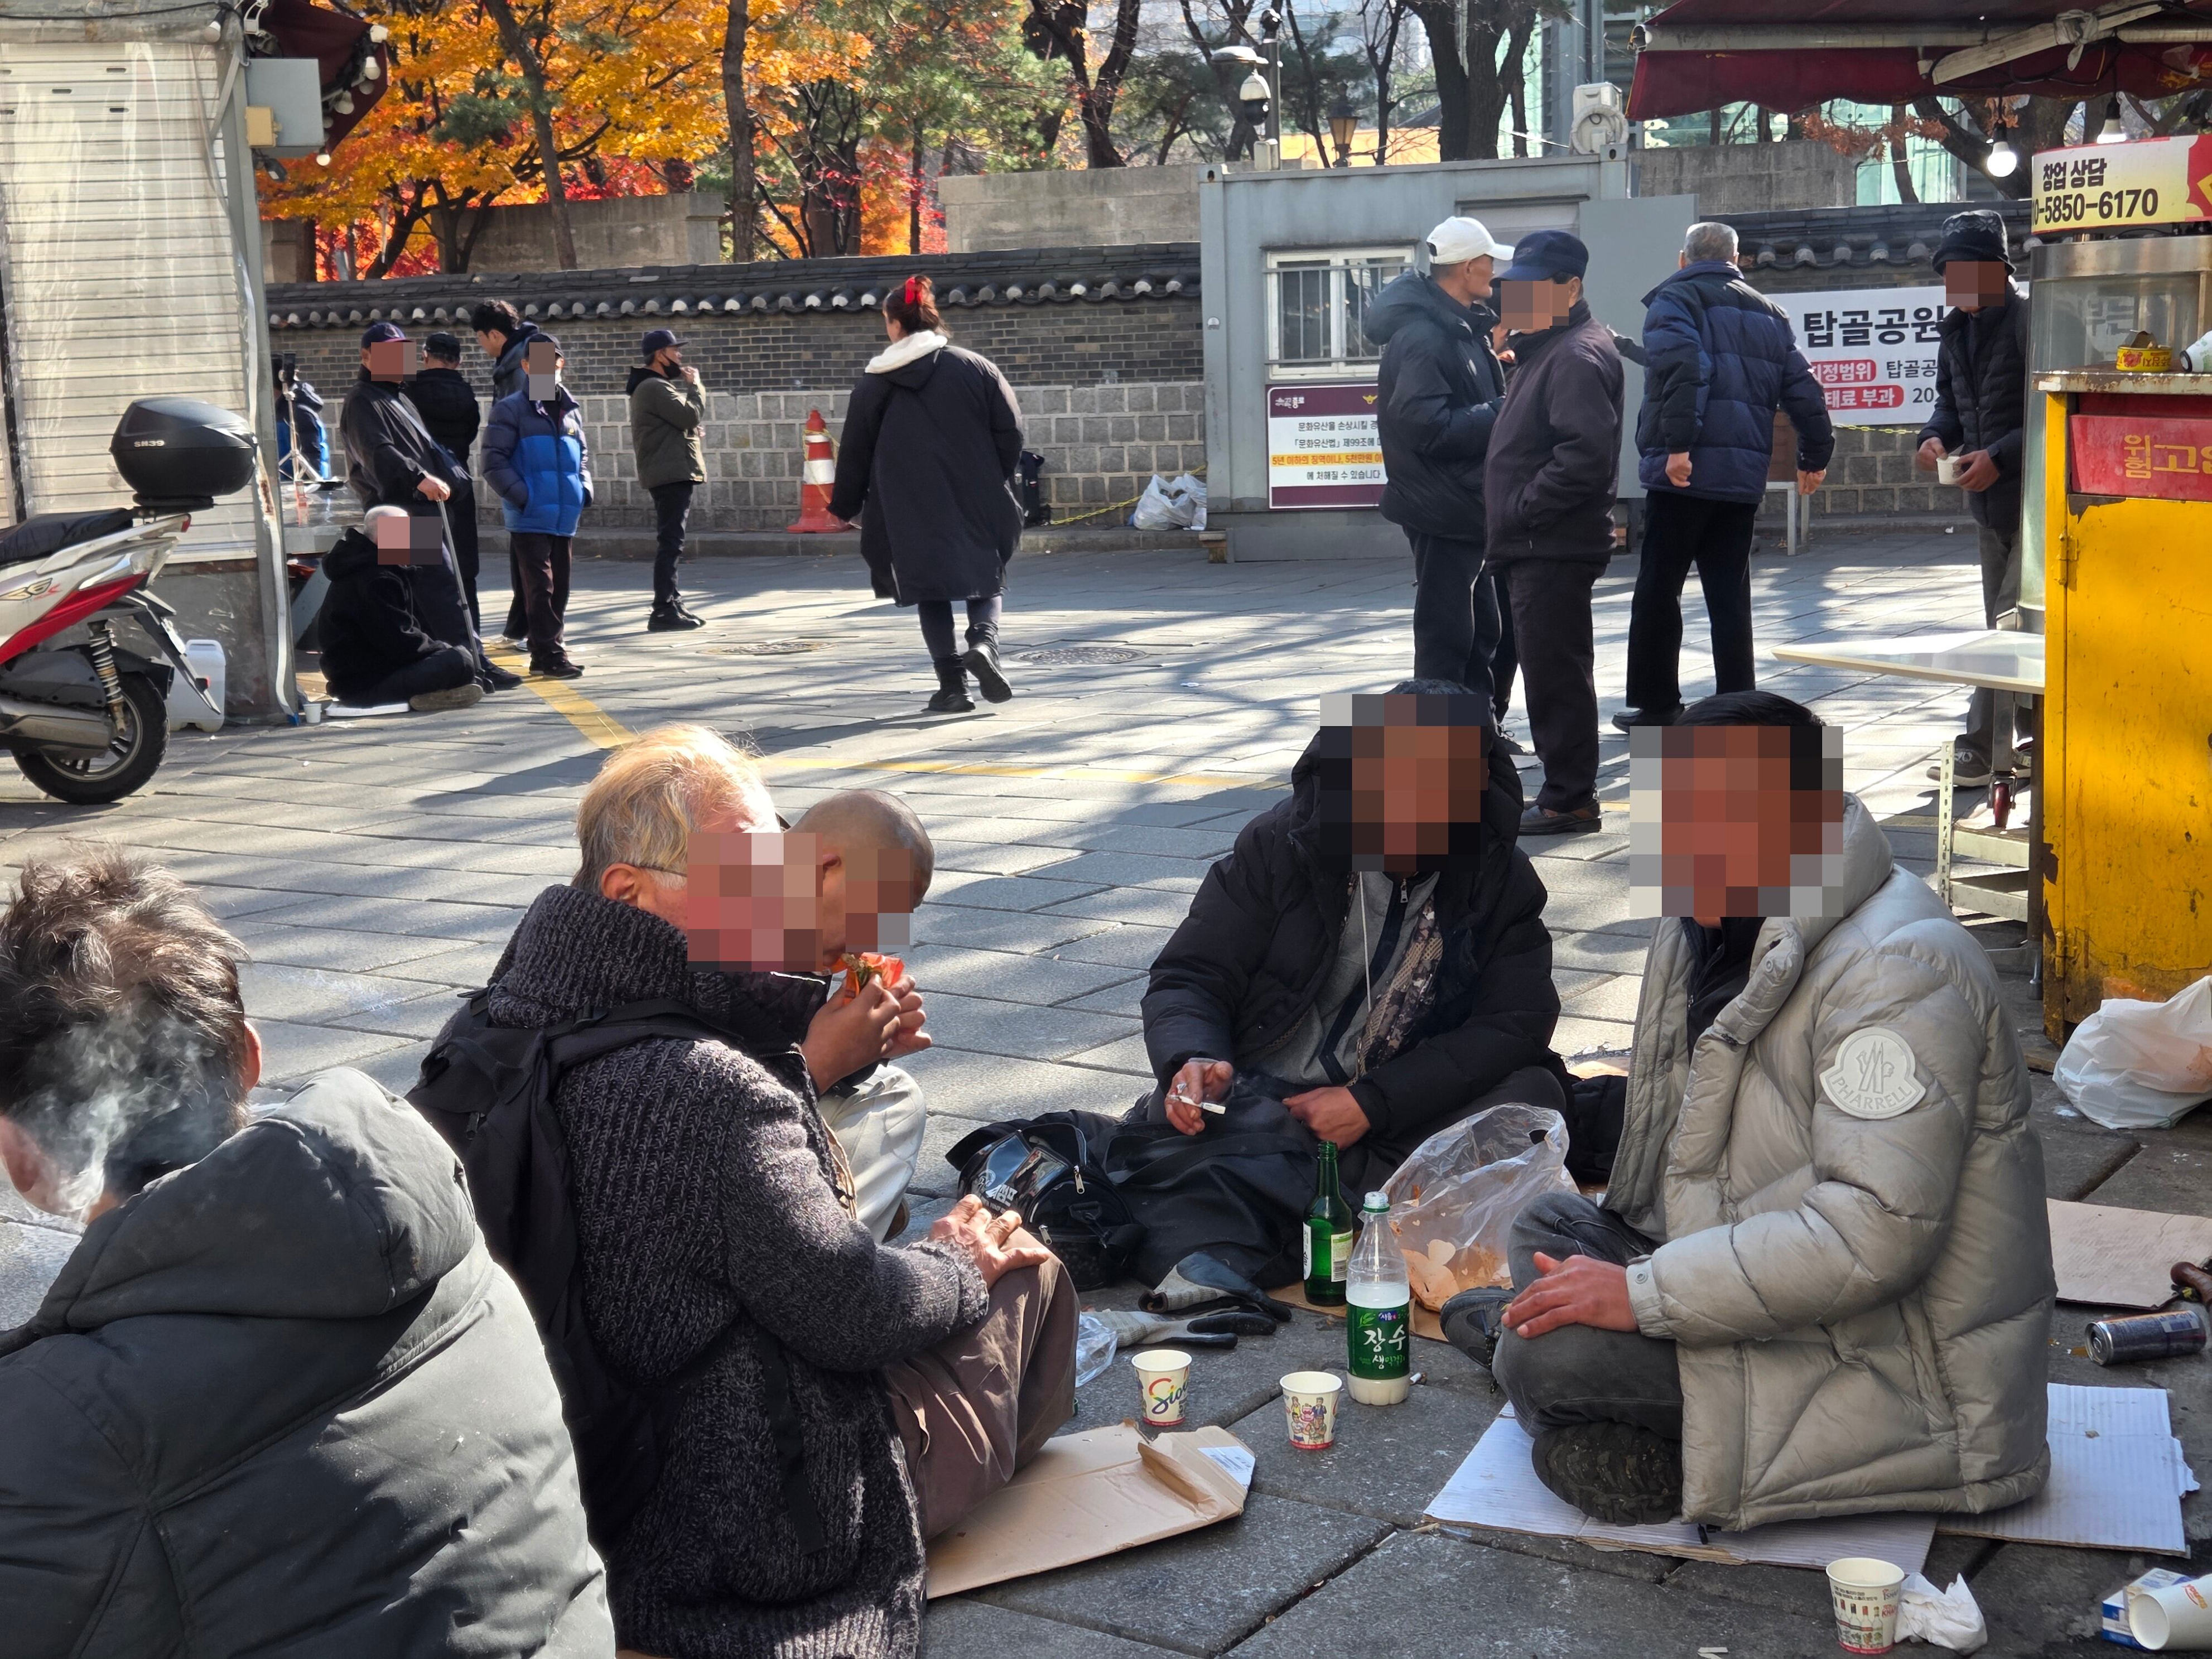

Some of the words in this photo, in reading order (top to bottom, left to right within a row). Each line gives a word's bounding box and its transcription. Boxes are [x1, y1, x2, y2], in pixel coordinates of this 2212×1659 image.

[2044, 161, 2067, 191] 창업
[2070, 158, 2107, 189] 상담
[1804, 305, 1944, 348] 탑골공원
[1862, 388, 1895, 407] 부과
[1298, 421, 1335, 432] 문화유산을
[1338, 420, 1367, 431] 손상시킬
[1343, 437, 1374, 447] 제99조에
[1272, 456, 1284, 465] 5년
[1287, 455, 1309, 465] 이하의
[1346, 454, 1372, 463] 5천만원
[1316, 471, 1338, 480] 처해질
[1341, 471, 1348, 480] 수
[1350, 470, 1381, 480] 있습니다
[1832, 1076, 1912, 1110] PHARRELL
[1363, 1324, 1406, 1353] 장수
